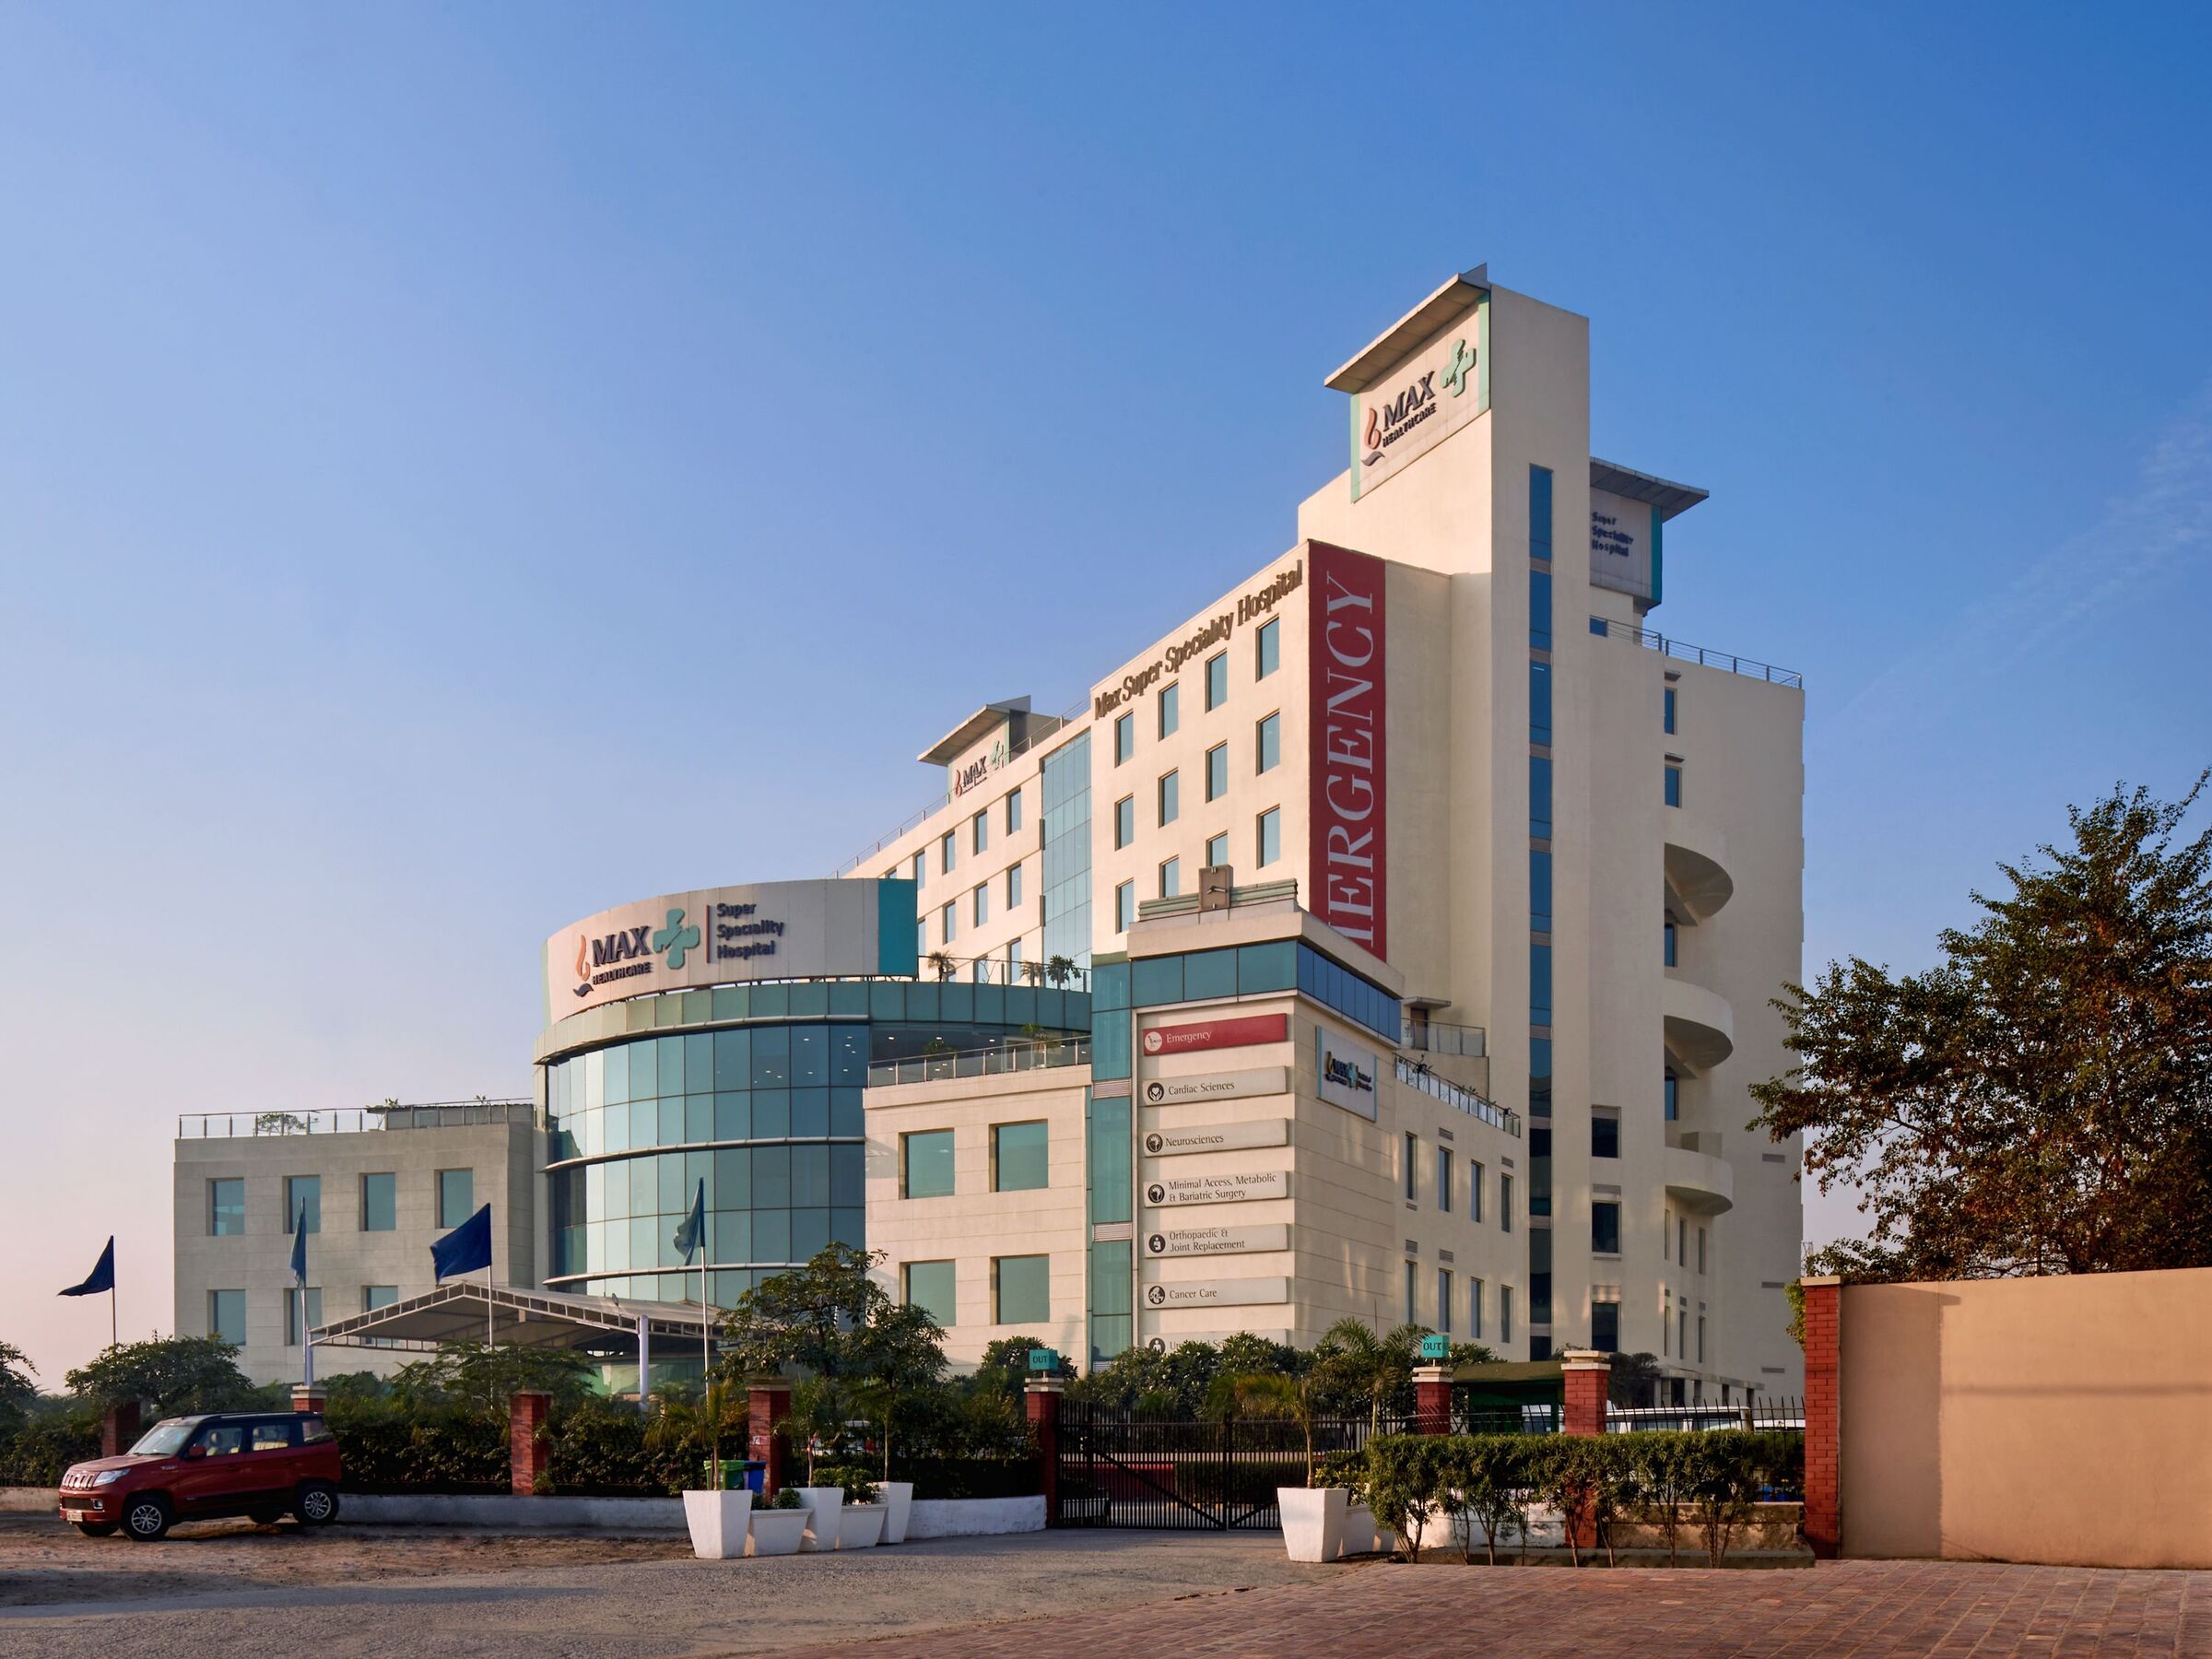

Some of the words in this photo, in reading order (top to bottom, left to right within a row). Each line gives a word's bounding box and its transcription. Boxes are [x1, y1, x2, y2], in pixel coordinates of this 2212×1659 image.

[1382, 371, 1435, 432] MAX
[1382, 402, 1437, 448] HEALTHCARE
[1094, 687, 1122, 721] Max
[1123, 660, 1162, 701] Super
[1164, 612, 1234, 674] Speciality
[1237, 559, 1302, 627] Hospital
[1326, 571, 1374, 947] ERGENCY
[962, 755, 987, 788] MAX
[717, 903, 757, 919] Super
[717, 920, 784, 940] Speciality
[592, 925, 653, 968] MAX
[717, 940, 776, 960] Hospital
[593, 961, 653, 985] HEALTHCARE
[1166, 1030, 1212, 1044] Emergency
[1168, 1084, 1198, 1096] Cardiac
[1200, 1081, 1235, 1092] Sciences
[1165, 1135, 1224, 1147] Neurosciences
[1169, 1179, 1202, 1190] Minimal
[1204, 1178, 1233, 1187] Access,
[1235, 1172, 1277, 1183] Metabolic
[1169, 1194, 1176, 1203] &
[1179, 1191, 1213, 1202] Bariatric
[1215, 1189, 1246, 1199] Surgery
[1169, 1228, 1218, 1241] Orthopaedic
[1220, 1229, 1229, 1237] &
[1170, 1242, 1191, 1253] Joint
[1193, 1240, 1245, 1253] Replacement
[1169, 1289, 1197, 1300] Cancer
[1199, 1288, 1218, 1298] Care
[1422, 1342, 1442, 1351] OUT
[1032, 1355, 1048, 1364] OUT
